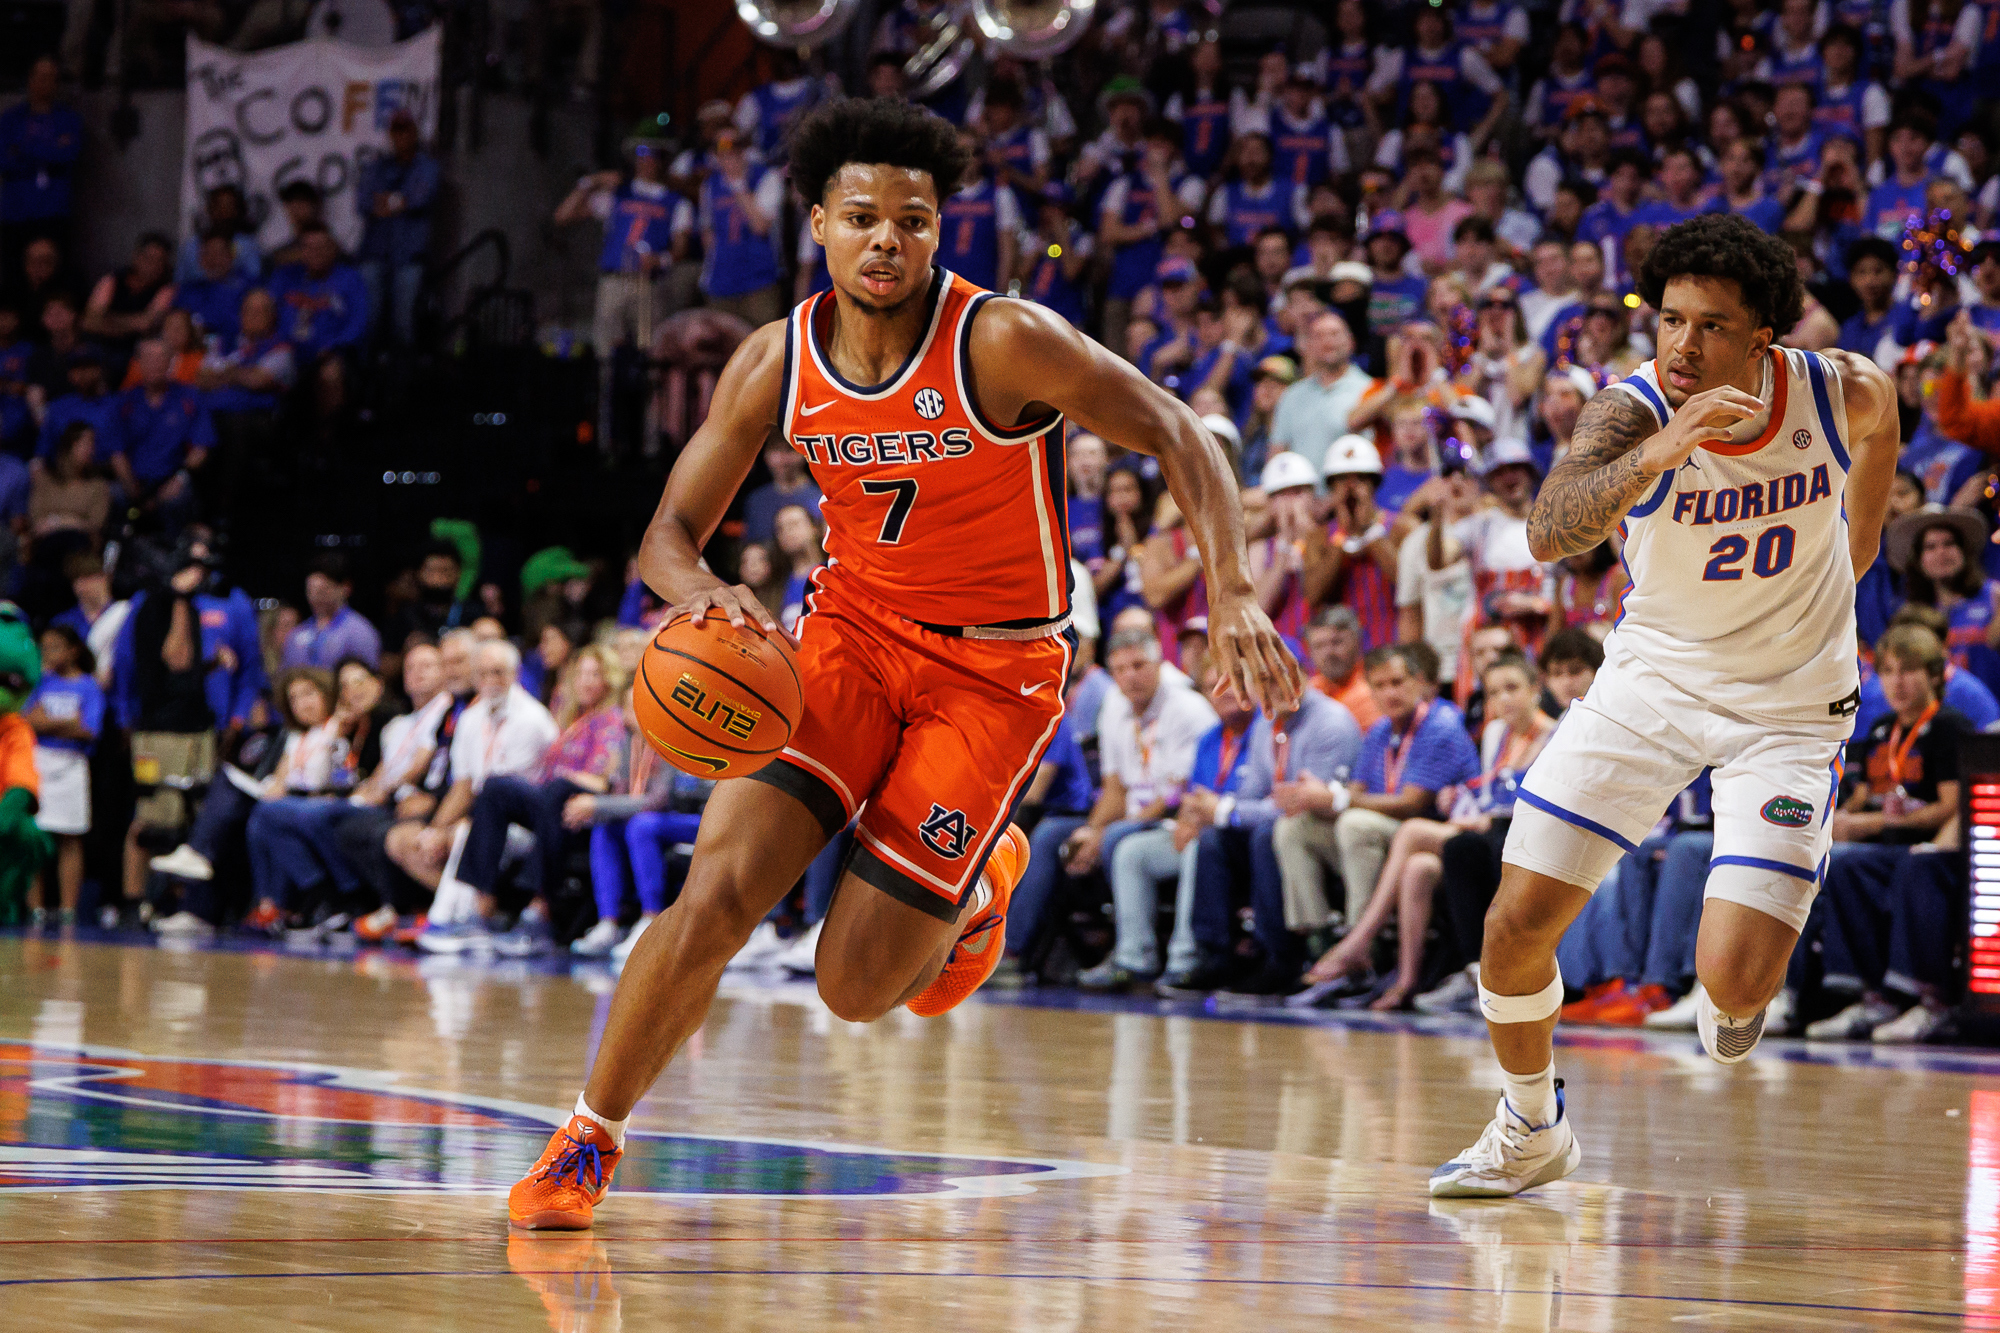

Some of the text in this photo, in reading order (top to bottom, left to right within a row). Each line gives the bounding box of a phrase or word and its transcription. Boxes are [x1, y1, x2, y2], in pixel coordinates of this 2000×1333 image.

[914, 387, 945, 419] SEC
[793, 427, 975, 466] TIGERS
[1793, 430, 1812, 449] SEC
[859, 478, 919, 544] 7
[1672, 462, 1832, 526] FLORIDA
[1702, 523, 1796, 581] 20
[670, 677, 759, 741] ELITE
[917, 801, 979, 861] AU
